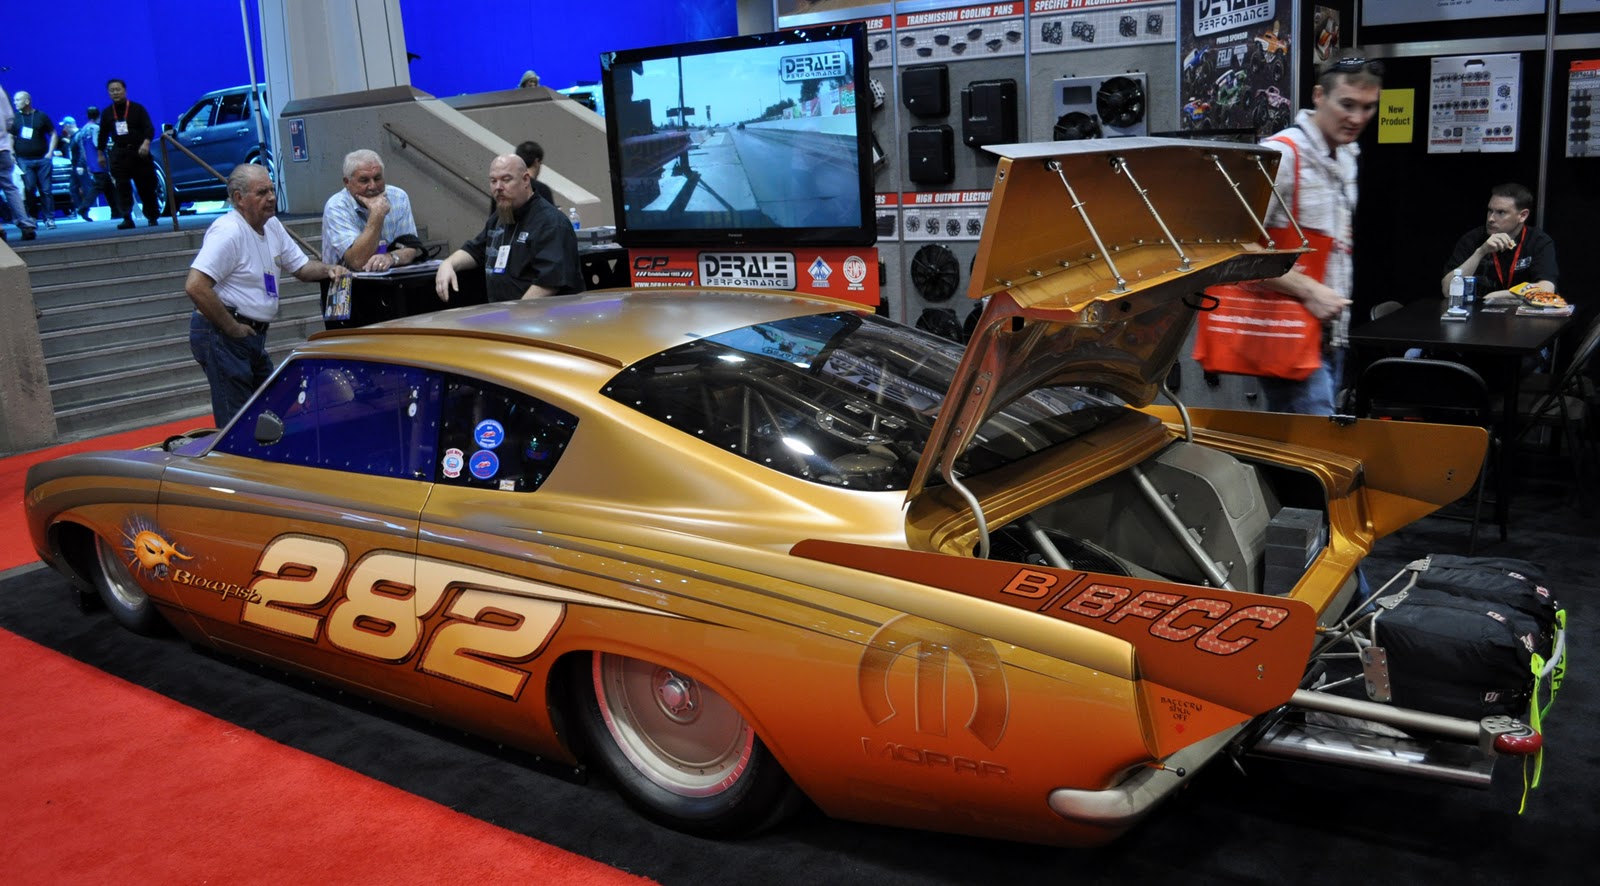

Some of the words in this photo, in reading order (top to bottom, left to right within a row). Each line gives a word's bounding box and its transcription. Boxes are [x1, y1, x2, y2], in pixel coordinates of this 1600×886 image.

[1034, 0, 1069, 11] SPECIFIC
[1071, 0, 1083, 8] FIT
[907, 11, 959, 25] TRANSMISSION
[960, 6, 991, 20] COOLING
[993, 4, 1014, 16] PANS
[1198, 6, 1269, 32] PERFORMANCE
[866, 18, 884, 30] LERS
[785, 54, 841, 74] DERALE
[786, 69, 842, 79] PERFORMANCE
[1388, 105, 1404, 114] New
[1380, 117, 1410, 126] Product
[915, 193, 932, 203] HIGH
[934, 193, 960, 203] OUTPUT
[633, 256, 669, 270] CP
[704, 255, 788, 278] DERALE
[706, 278, 789, 287] PERFORMANCE
[173, 569, 262, 605] Blowfish
[240, 532, 568, 702] 282
